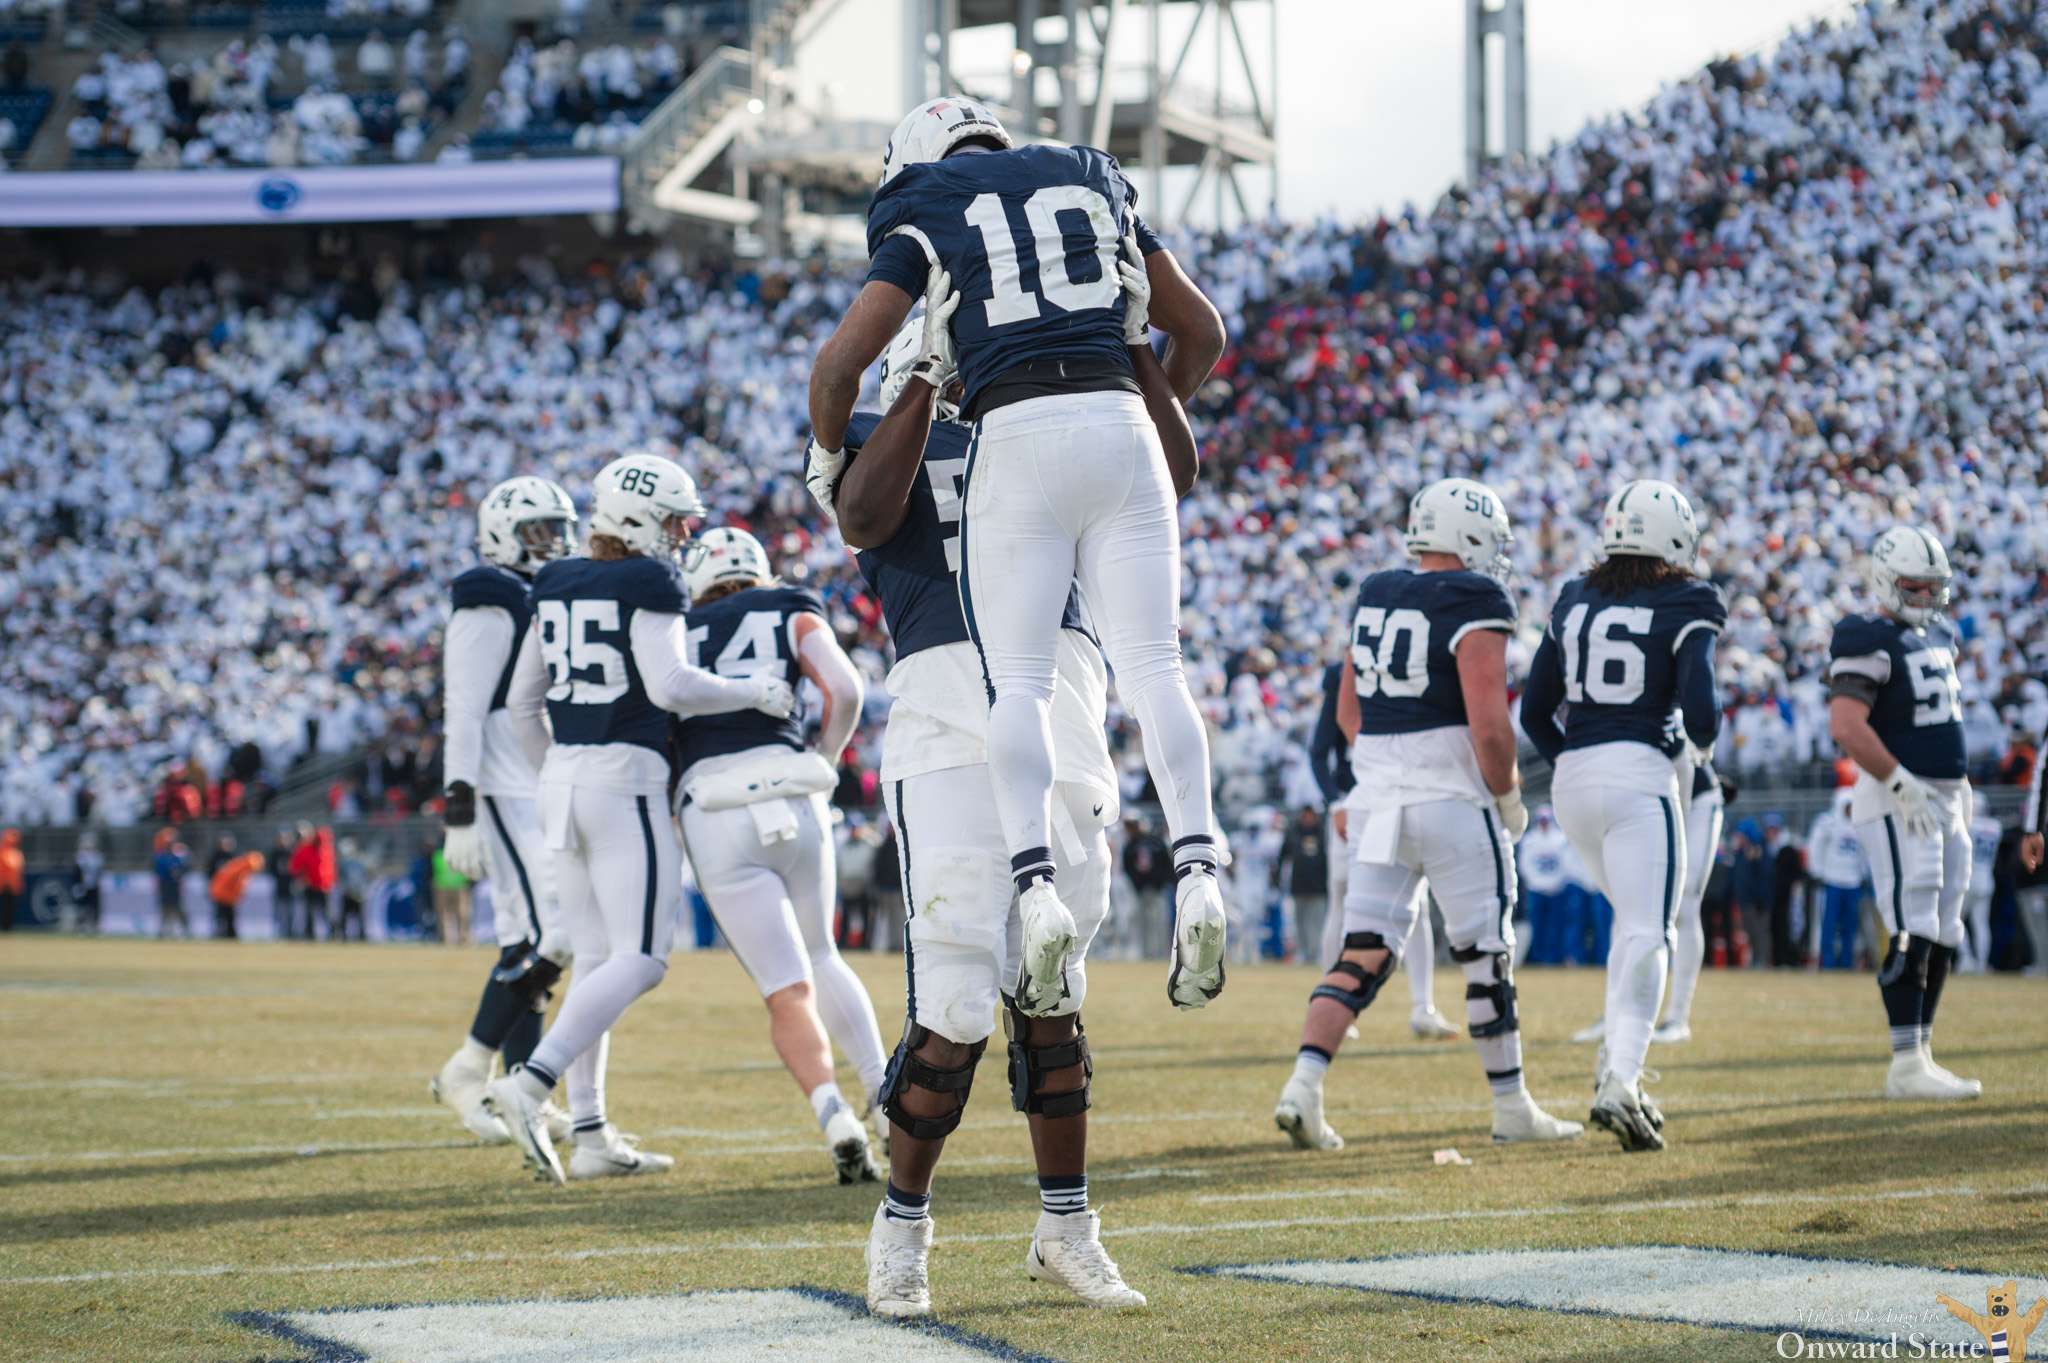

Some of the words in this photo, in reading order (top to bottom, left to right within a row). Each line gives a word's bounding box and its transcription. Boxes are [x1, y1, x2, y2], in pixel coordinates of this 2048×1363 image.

[963, 185, 1123, 327] 10
[620, 468, 660, 498] 85
[1465, 490, 1493, 519] 50
[537, 599, 631, 705] 85
[1351, 606, 1431, 698] 50
[1562, 602, 1655, 705] 16
